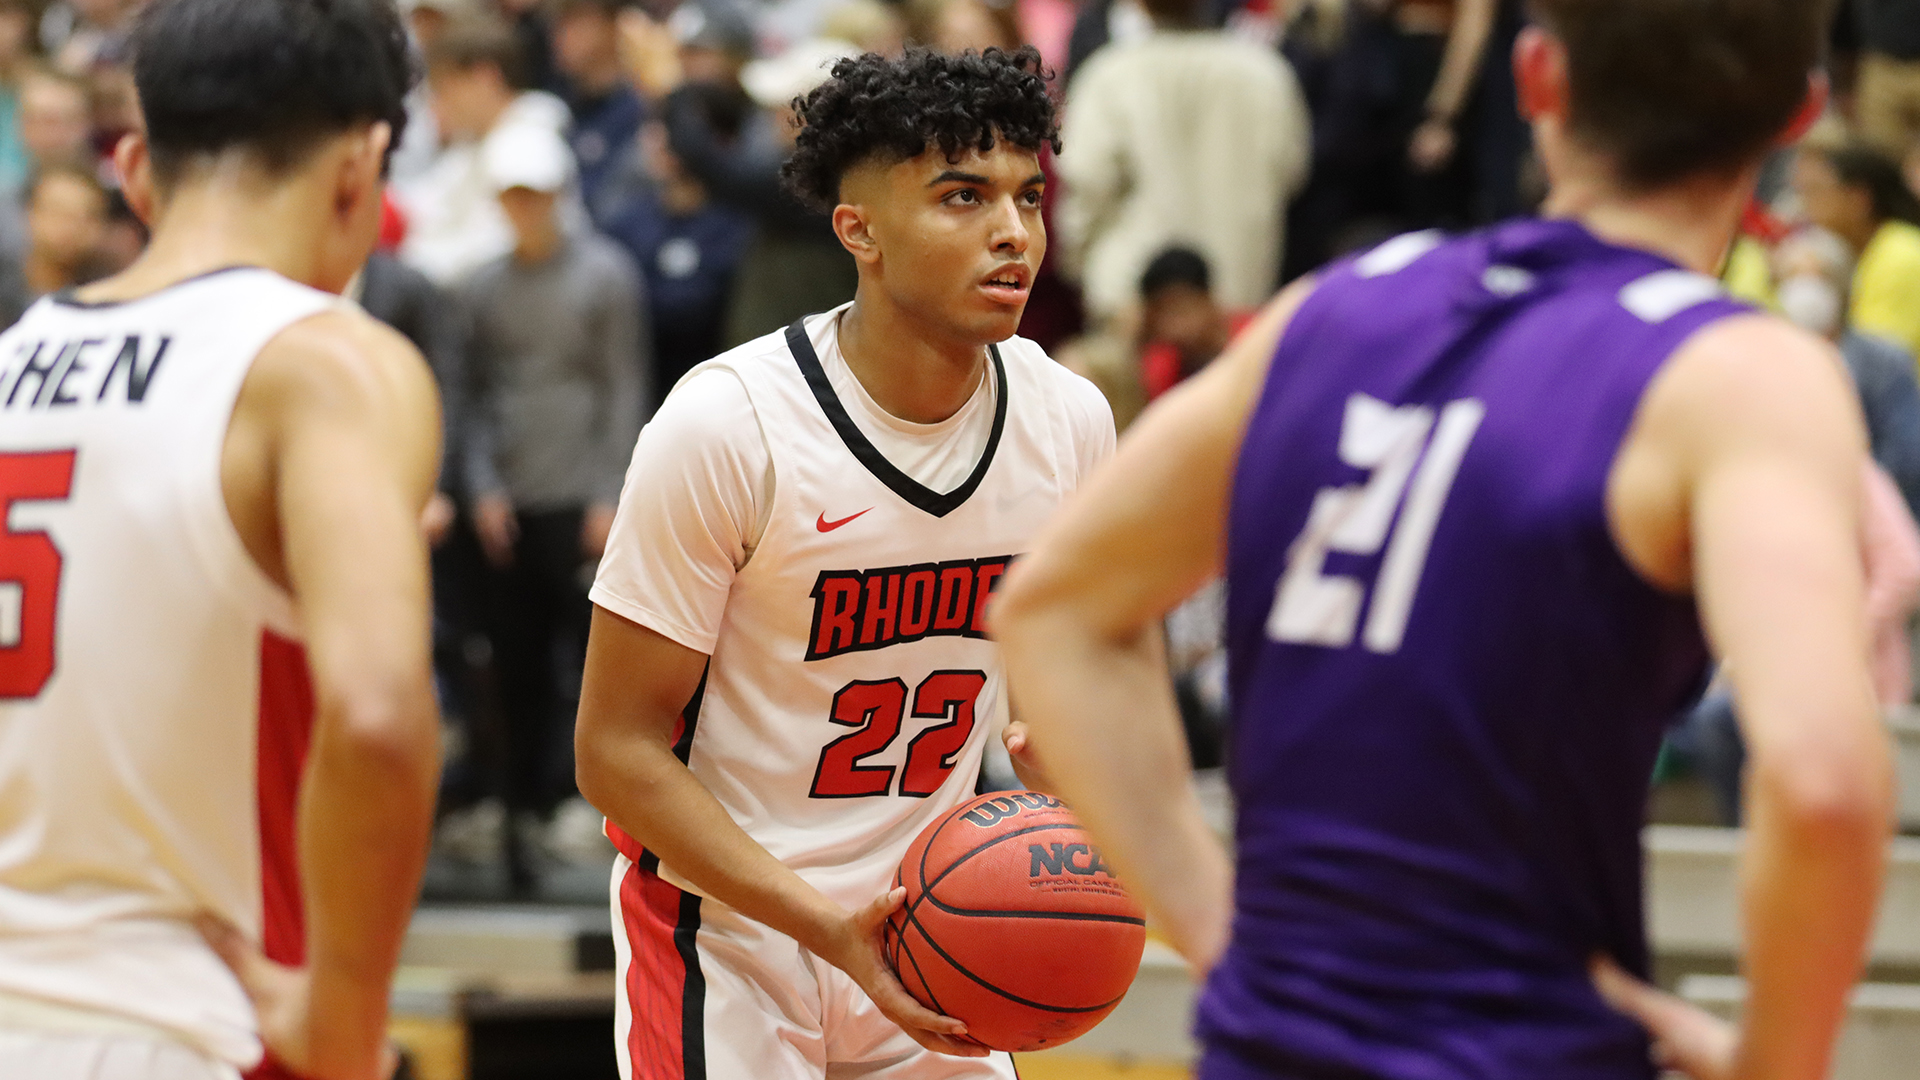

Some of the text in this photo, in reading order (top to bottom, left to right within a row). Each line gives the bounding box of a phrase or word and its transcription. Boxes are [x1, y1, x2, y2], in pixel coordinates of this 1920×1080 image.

[1266, 392, 1486, 655] 21
[804, 553, 1025, 662] RHODE
[808, 669, 987, 798] 22
[1030, 879, 1080, 888] OFFICIAL
[1083, 879, 1111, 888] GAME
